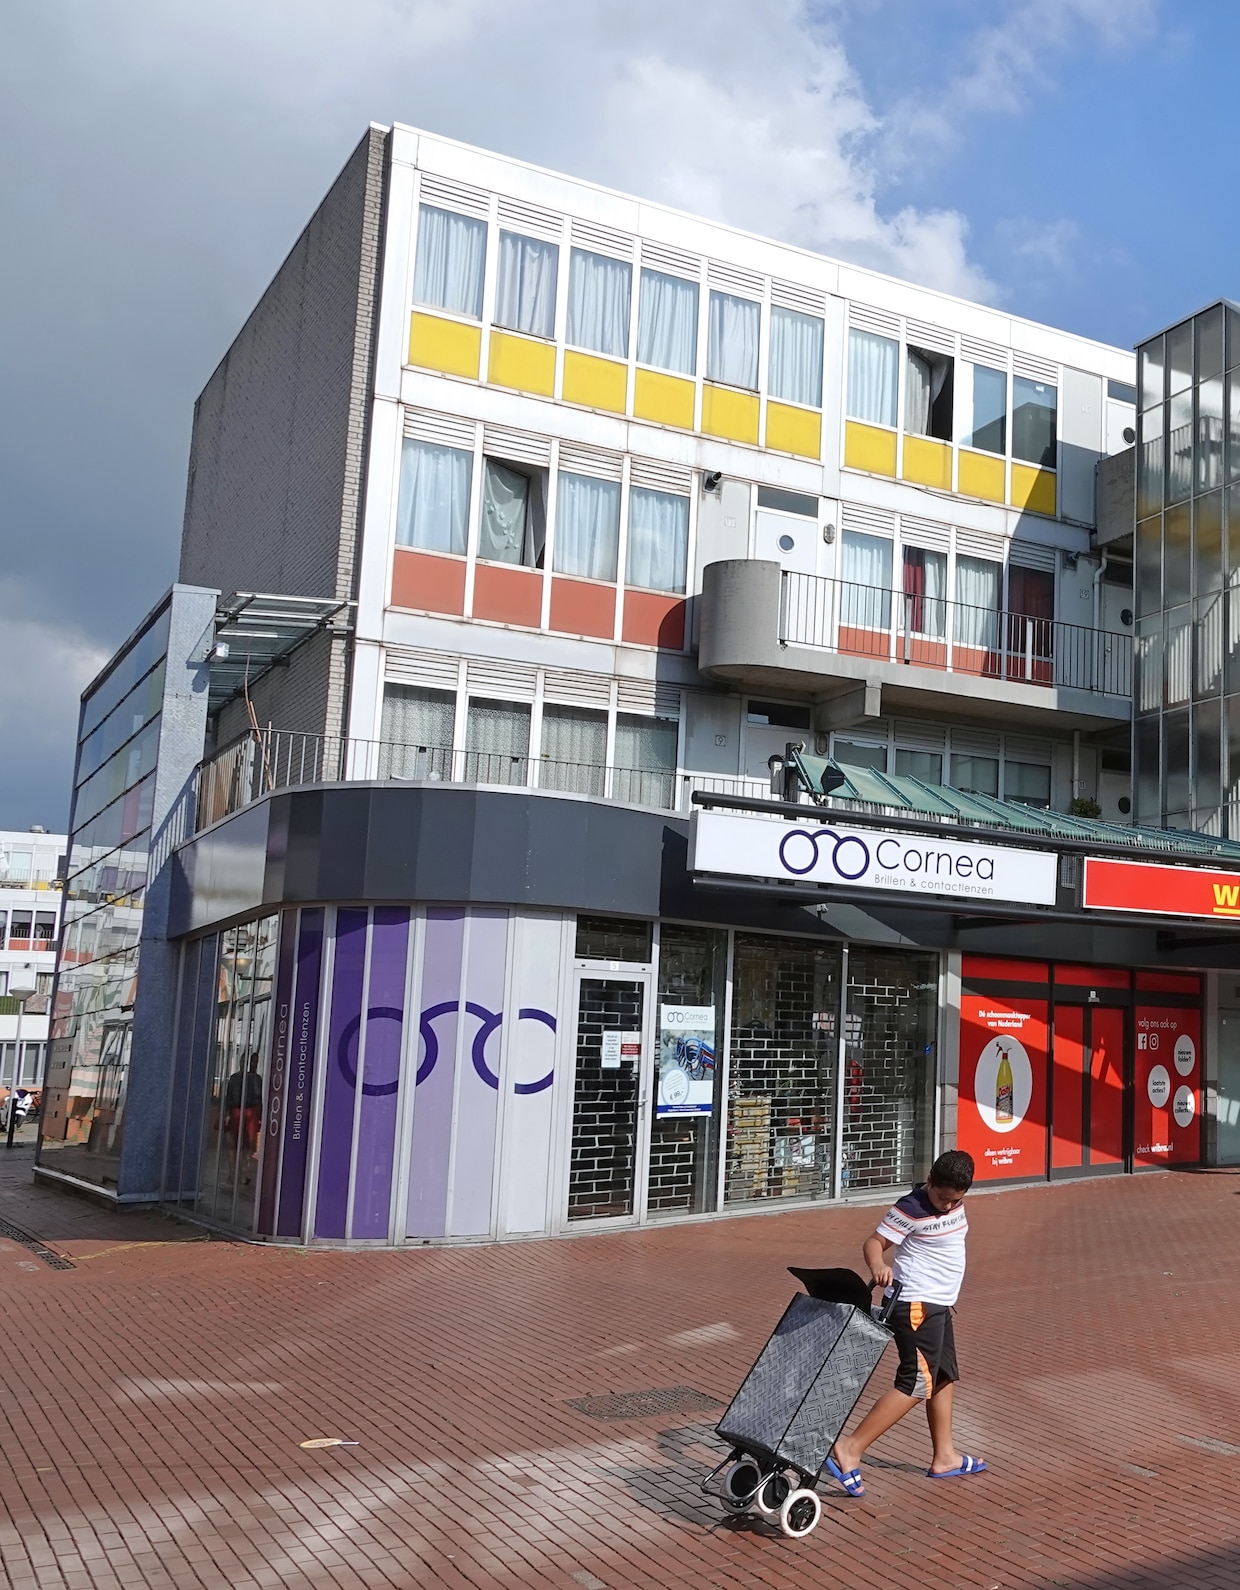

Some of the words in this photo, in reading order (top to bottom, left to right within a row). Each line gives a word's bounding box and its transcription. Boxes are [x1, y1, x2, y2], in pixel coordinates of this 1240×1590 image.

[876, 838, 994, 880] Cornea
[874, 874, 906, 887] Brillen
[909, 878, 917, 888] &
[920, 881, 994, 895] contactlenzen
[684, 1012, 708, 1022] Cornea
[998, 1020, 1023, 1028] Nederland
[1138, 1017, 1149, 1030] volg
[1150, 1020, 1159, 1028] ons
[1160, 1018, 1169, 1028] ook
[1169, 1021, 1177, 1030] op
[273, 1004, 288, 1091] Cornea
[298, 1002, 310, 1090] contactlenzen
[1152, 1086, 1166, 1094] acties?
[296, 1093, 304, 1101] &
[292, 1105, 303, 1140] Brillen
[1137, 1145, 1150, 1153] check
[1151, 1142, 1174, 1153] wibra.nl
[998, 1156, 1013, 1165] wibra
